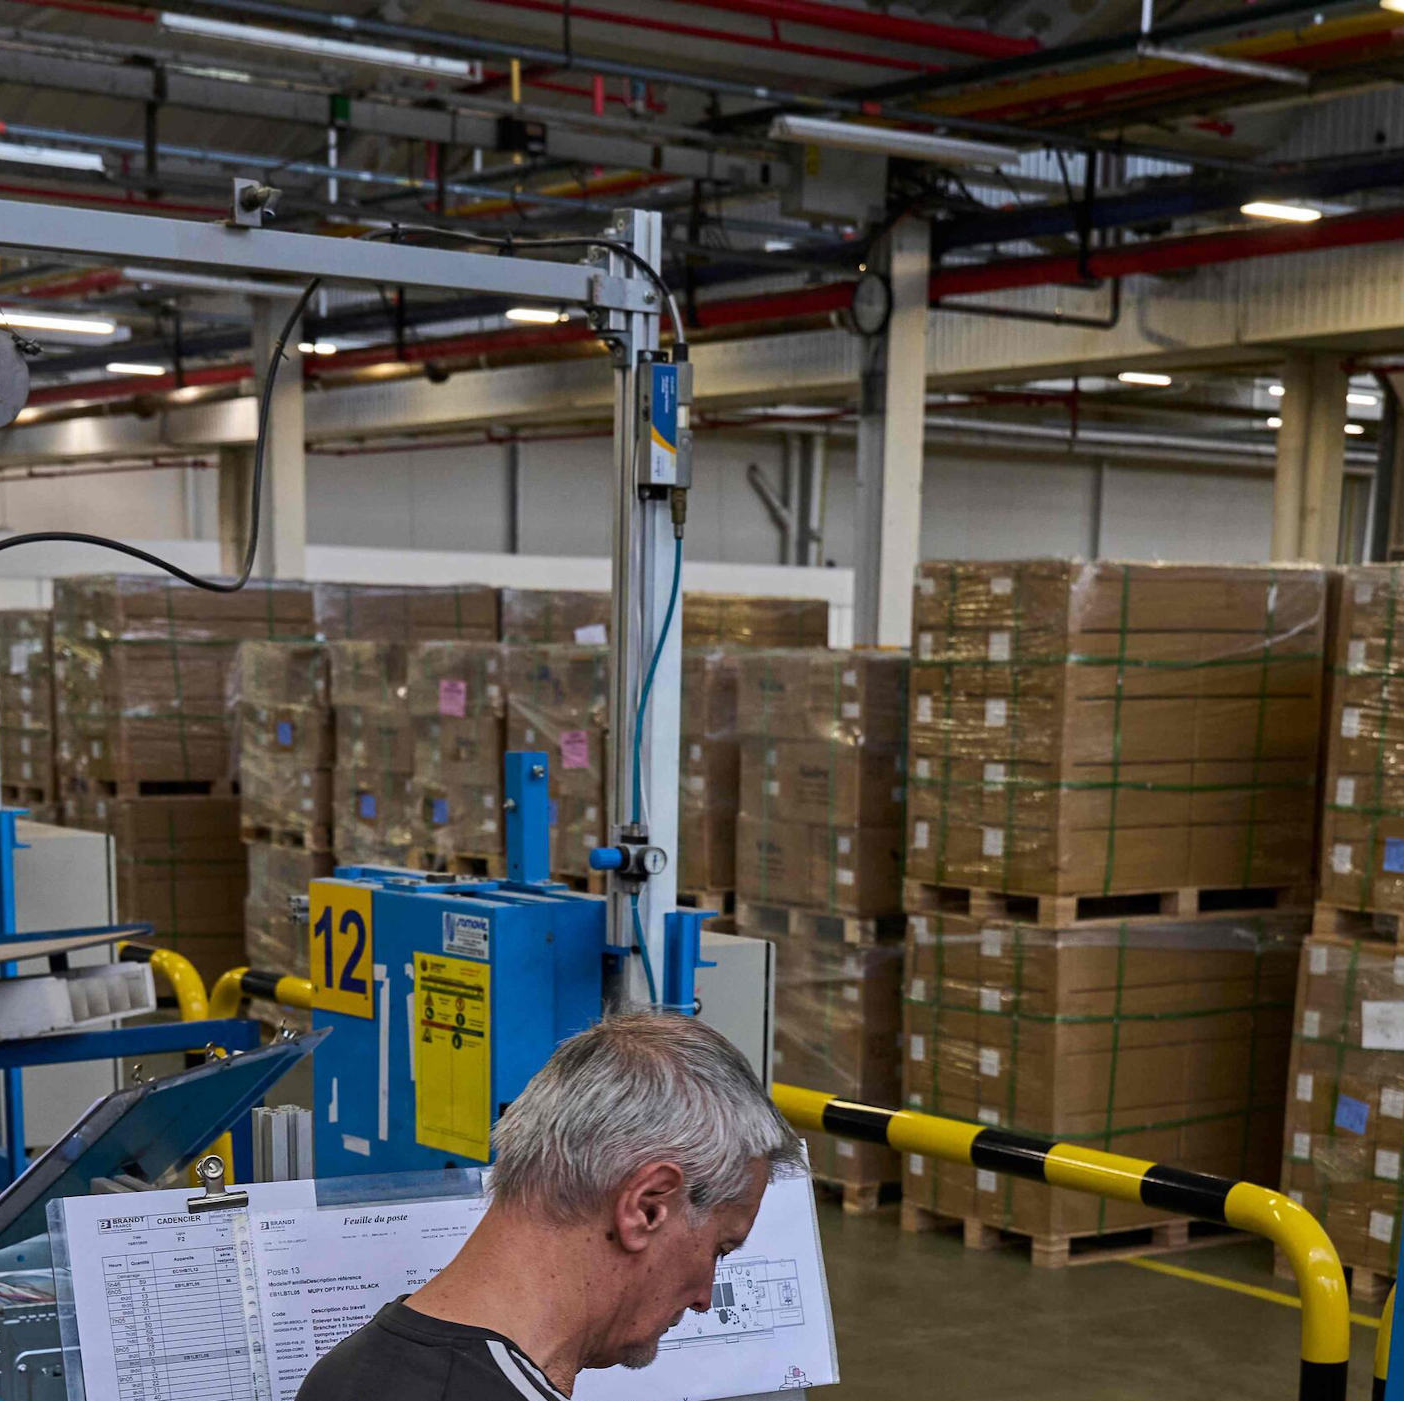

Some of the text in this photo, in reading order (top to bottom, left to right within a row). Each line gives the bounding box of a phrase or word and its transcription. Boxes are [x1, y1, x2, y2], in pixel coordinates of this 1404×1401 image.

[314, 905, 367, 994] 12
[112, 1215, 145, 1225] BRANDT
[157, 1214, 201, 1225] CADENCIER
[270, 1218, 295, 1226] BRANDT
[343, 1213, 408, 1226] Feuille du poste
[267, 1266, 301, 1277] Poste 13
